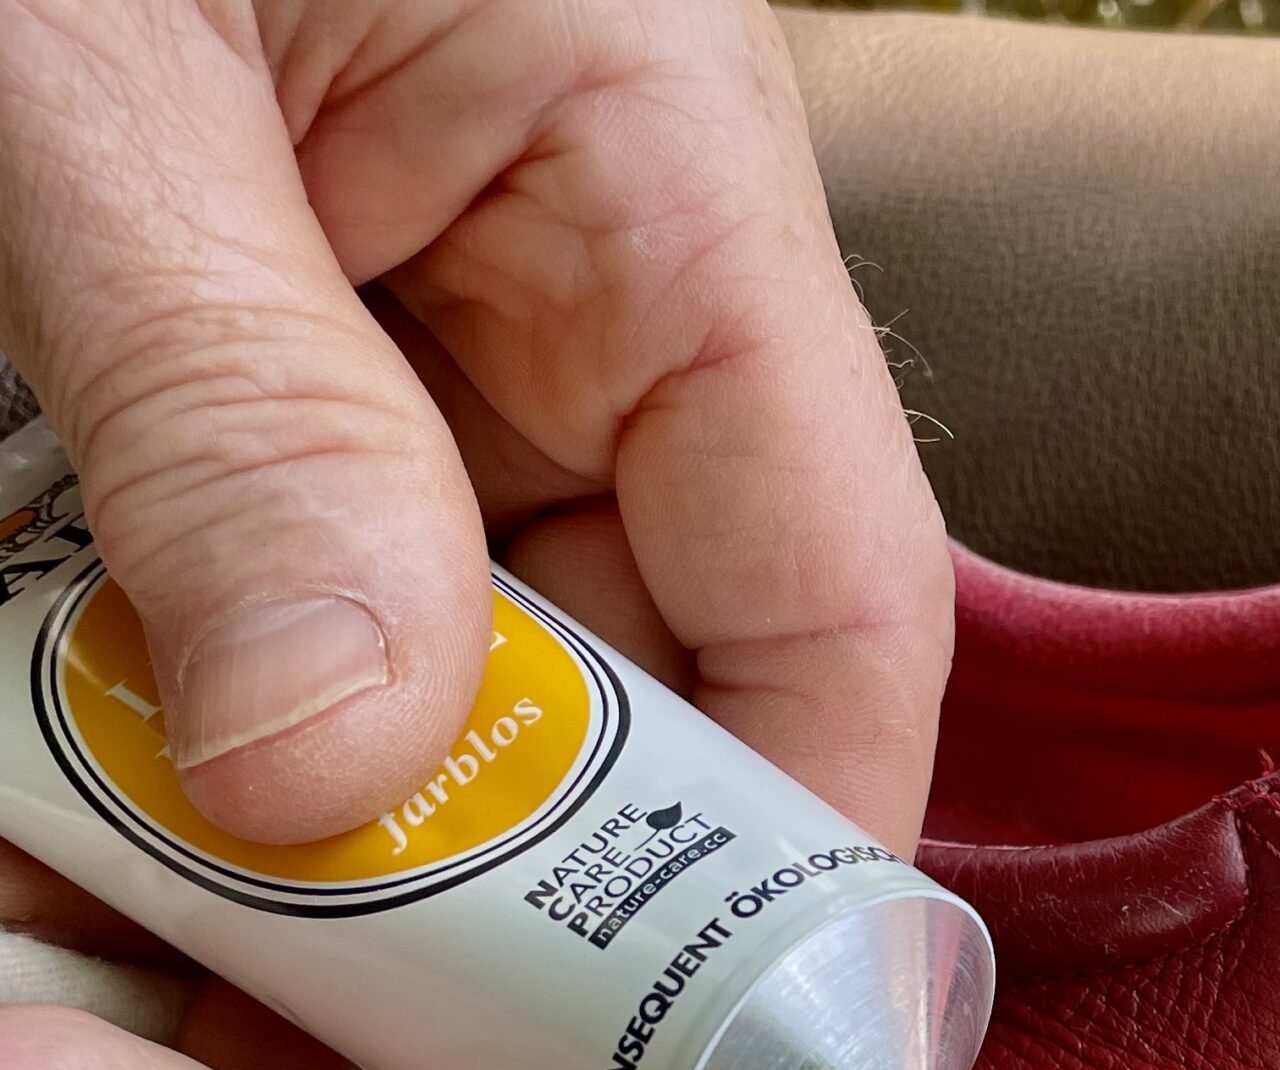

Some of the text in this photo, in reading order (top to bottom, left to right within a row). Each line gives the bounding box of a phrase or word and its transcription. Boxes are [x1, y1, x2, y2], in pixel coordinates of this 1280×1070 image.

[524, 803, 648, 910] NATURE
[548, 847, 632, 921] CARE
[567, 813, 711, 938] PRODUCT
[597, 832, 727, 941] nature-care.cc
